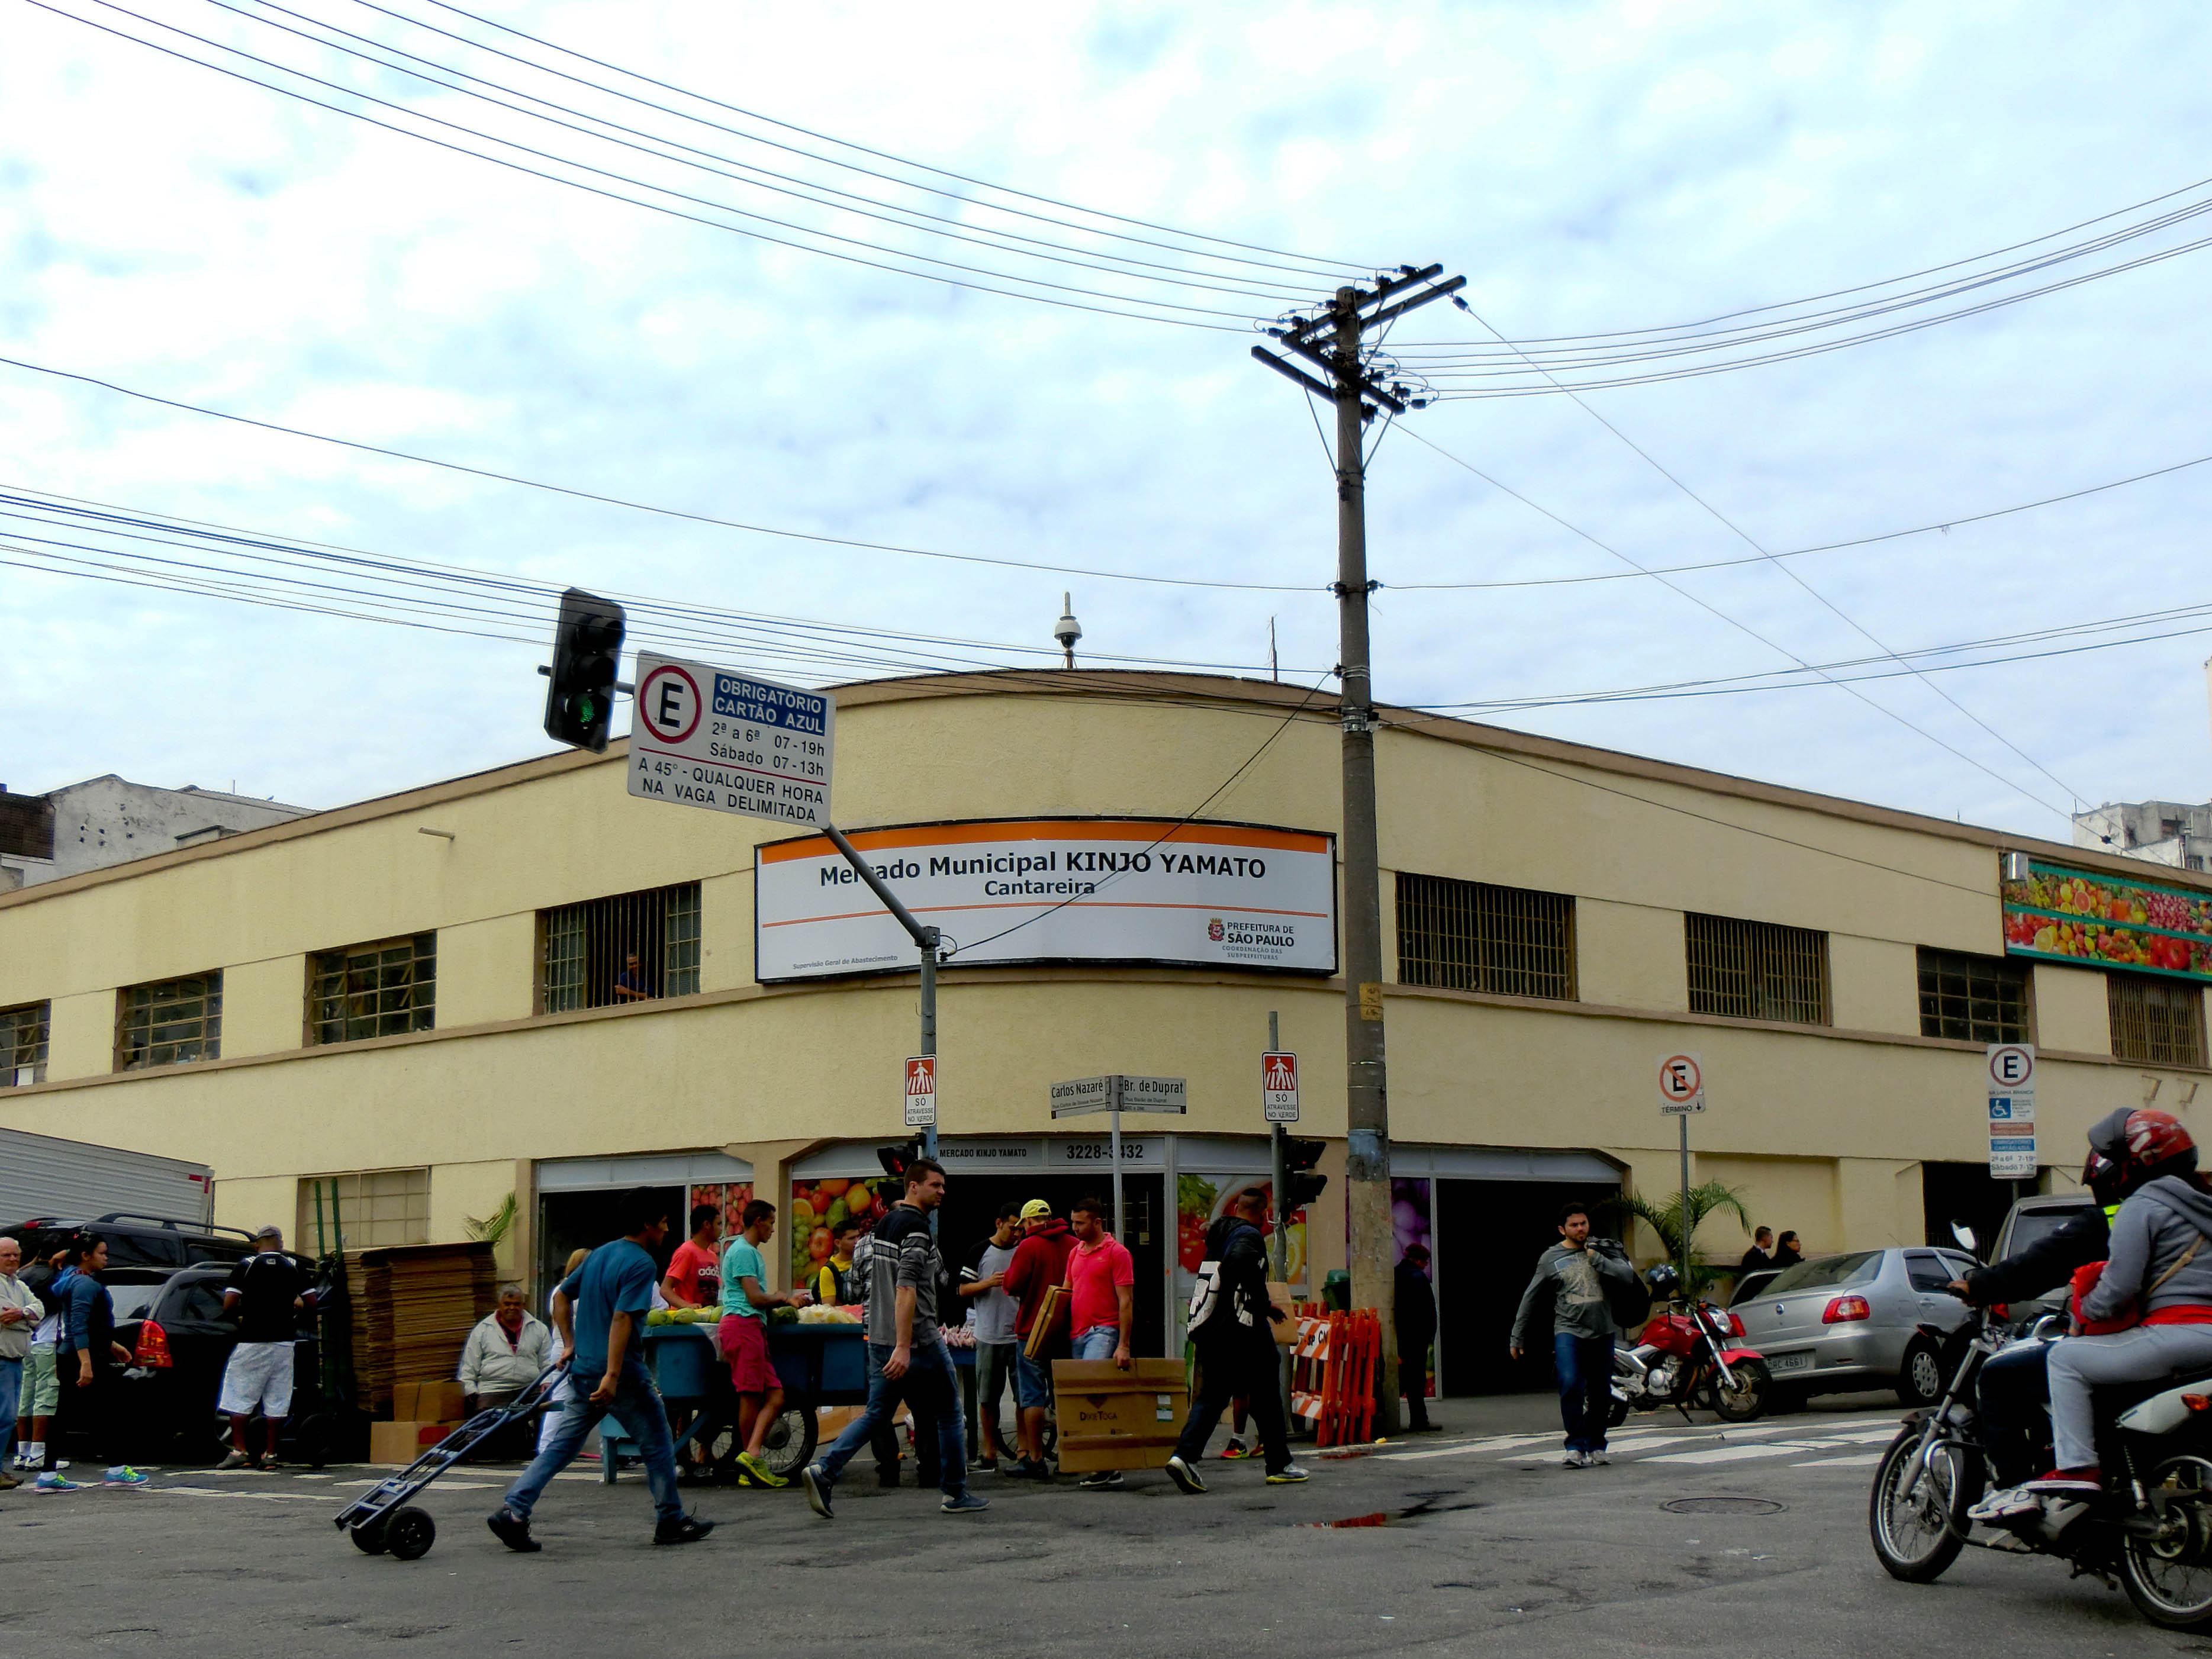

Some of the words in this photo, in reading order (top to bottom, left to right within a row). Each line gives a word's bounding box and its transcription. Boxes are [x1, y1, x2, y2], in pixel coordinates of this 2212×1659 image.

[659, 681, 684, 728] E
[720, 678, 821, 713] OBRIGATÓRIO
[715, 697, 777, 723] CARTÃO
[785, 713, 823, 733] AZUL
[712, 723, 727, 736] 2ª
[733, 729, 739, 739] a
[746, 729, 760, 742] 6ª
[710, 742, 763, 765] Sábado
[639, 758, 648, 772] A
[693, 768, 775, 796] QUALQUER
[783, 785, 823, 804] HORA
[643, 778, 664, 795] NA
[675, 784, 716, 804] VAGA
[728, 794, 816, 822] DELIMITADA
[820, 859, 920, 886] Merado
[930, 851, 1055, 877] Municipal
[1066, 852, 1151, 872] KINJO
[1160, 853, 1266, 878] YAMATO
[985, 879, 1095, 895] Cantareira
[1228, 922, 1280, 933] PREFEITURA
[1228, 931, 1253, 944] SÃO
[1256, 935, 1294, 947] PAULO
[793, 961, 823, 969] Supervisão
[851, 955, 898, 964] Abastecimento
[2004, 1056, 2018, 1078] E
[1672, 1065, 1687, 1091] E
[1051, 1084, 1074, 1099] Carlos
[1076, 1079, 1103, 1094] Nazaré
[1125, 1080, 1135, 1091] Br.
[1139, 1080, 1150, 1092] de
[1152, 1081, 1183, 1096] Duprat
[1276, 1091, 1287, 1102] SÓ
[915, 1096, 926, 1106] SÓ
[1662, 1104, 1692, 1113] TÉRMINO
[939, 1149, 974, 1158] MERCADO
[976, 1149, 996, 1157] KINJO
[999, 1148, 1026, 1157] YAMATO
